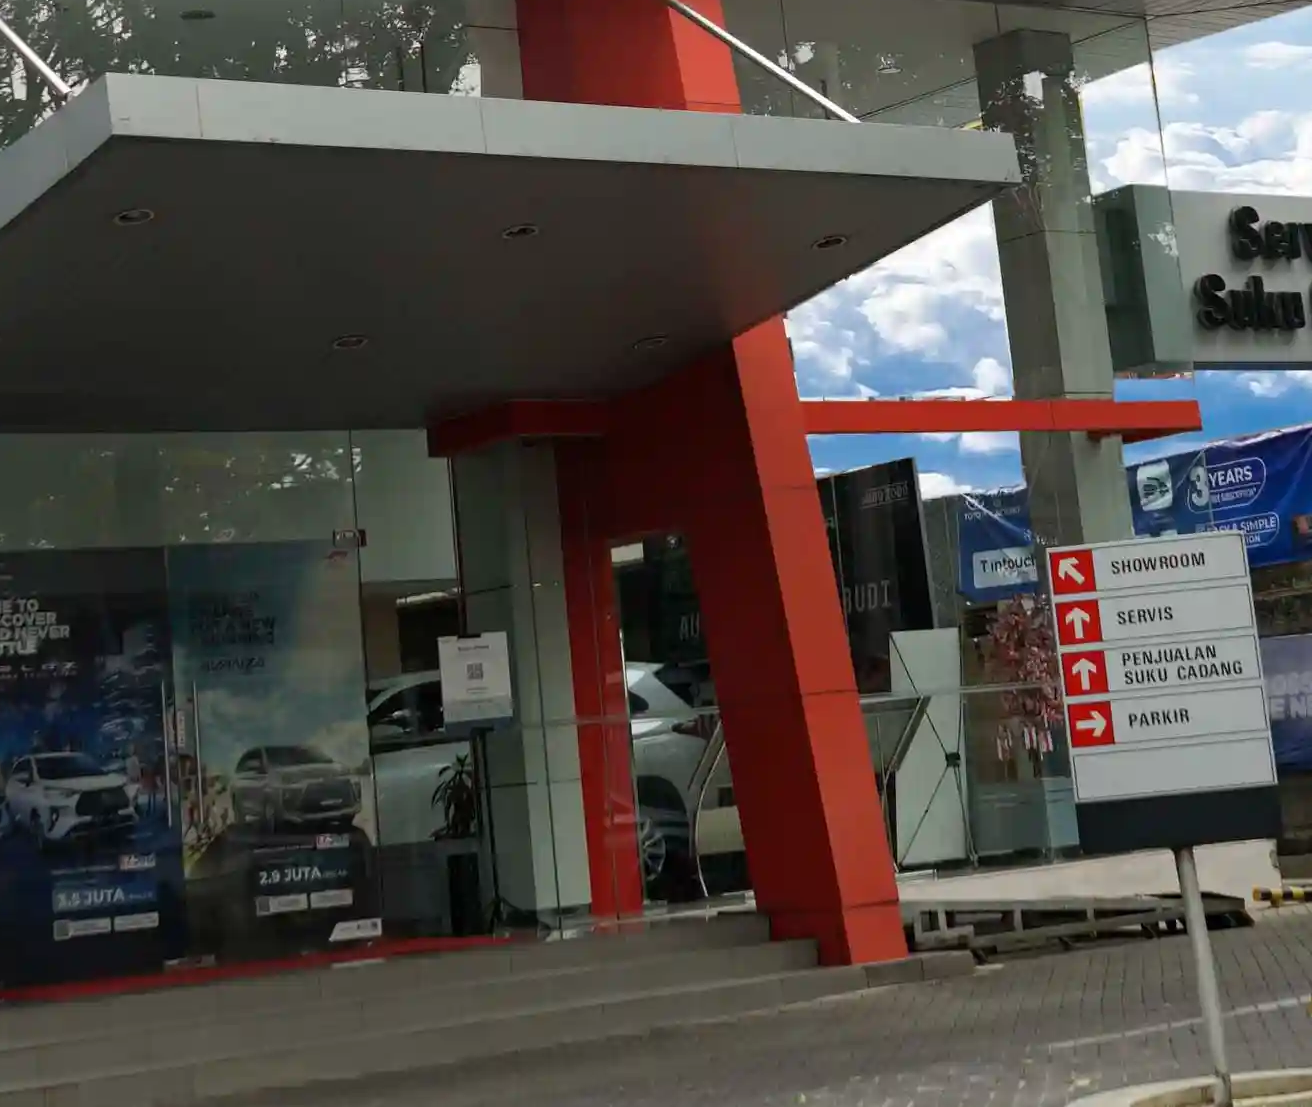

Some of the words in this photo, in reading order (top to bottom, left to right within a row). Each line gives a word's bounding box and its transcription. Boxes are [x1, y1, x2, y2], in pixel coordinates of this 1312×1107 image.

[1193, 274, 1305, 330] Suku
[1190, 466, 1209, 506] 3
[1209, 466, 1253, 487] YEARS
[1111, 552, 1205, 575] SHOWROOM
[19, 599, 39, 613] TO
[1118, 606, 1174, 625] SERVIS
[1122, 644, 1217, 666] PENJUALAN
[1124, 668, 1168, 685] SUKU
[1177, 660, 1243, 681] CADANG
[1128, 707, 1190, 728] PARKIR
